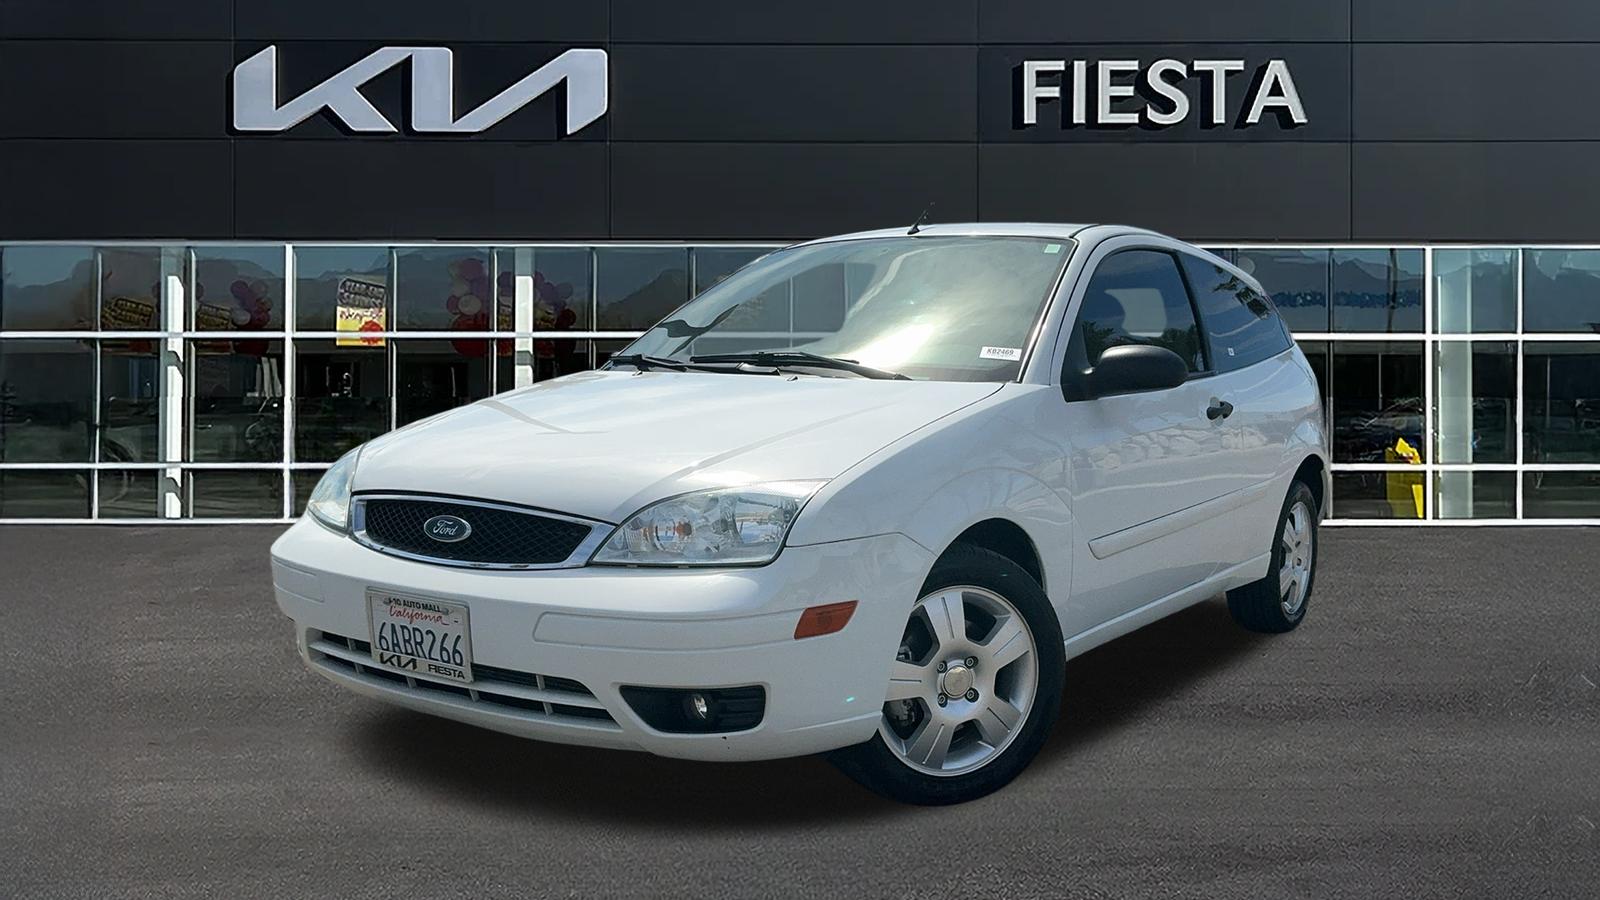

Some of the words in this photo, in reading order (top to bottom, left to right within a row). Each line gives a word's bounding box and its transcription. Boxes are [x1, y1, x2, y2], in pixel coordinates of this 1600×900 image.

[233, 44, 608, 135] KIA
[1022, 58, 1308, 125] FIESTA
[432, 519, 459, 536] Ford
[389, 605, 450, 626] California
[402, 599, 421, 609] AUTO
[421, 602, 442, 613] MALL
[378, 621, 464, 667] 6ABR266
[379, 652, 418, 670] KIA
[428, 663, 466, 680] FIESTA
